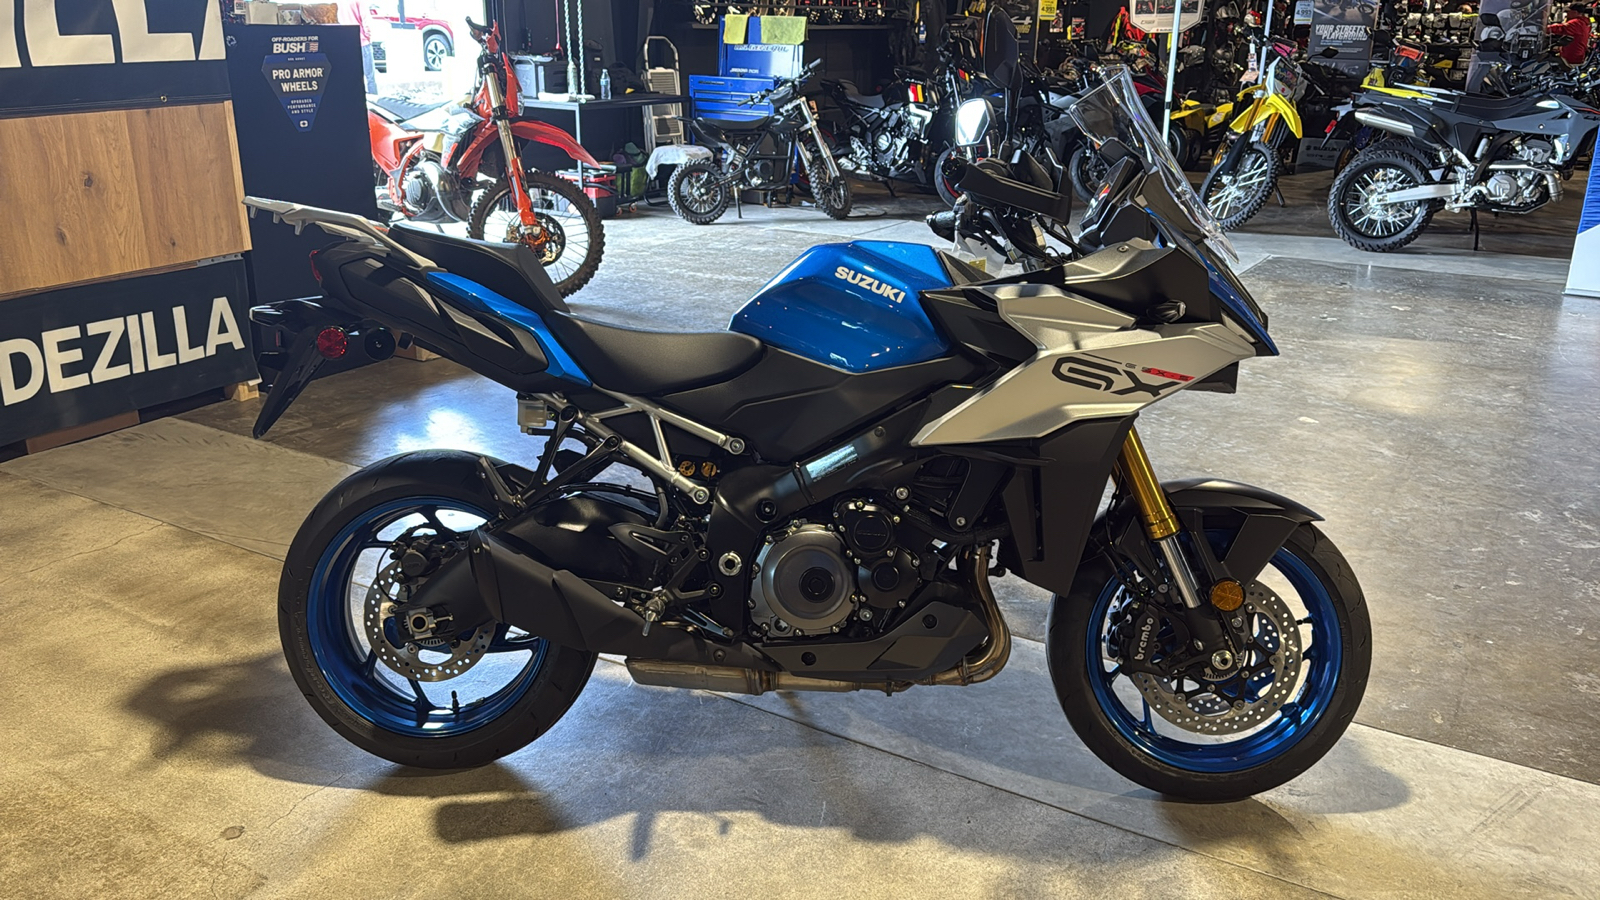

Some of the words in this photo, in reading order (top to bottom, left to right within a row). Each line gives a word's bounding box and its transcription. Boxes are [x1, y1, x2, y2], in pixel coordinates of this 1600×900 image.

[1316, 24, 1335, 34] YOUR
[1335, 25, 1366, 34] STREETS
[273, 42, 306, 54] BUSH
[272, 69, 291, 80] PRO
[293, 68, 324, 79] ARMOR
[281, 81, 318, 92] WHEELS
[834, 266, 907, 304] SUZUKI
[0, 296, 246, 407] DEZILLA
[1134, 617, 1154, 660] brembo
